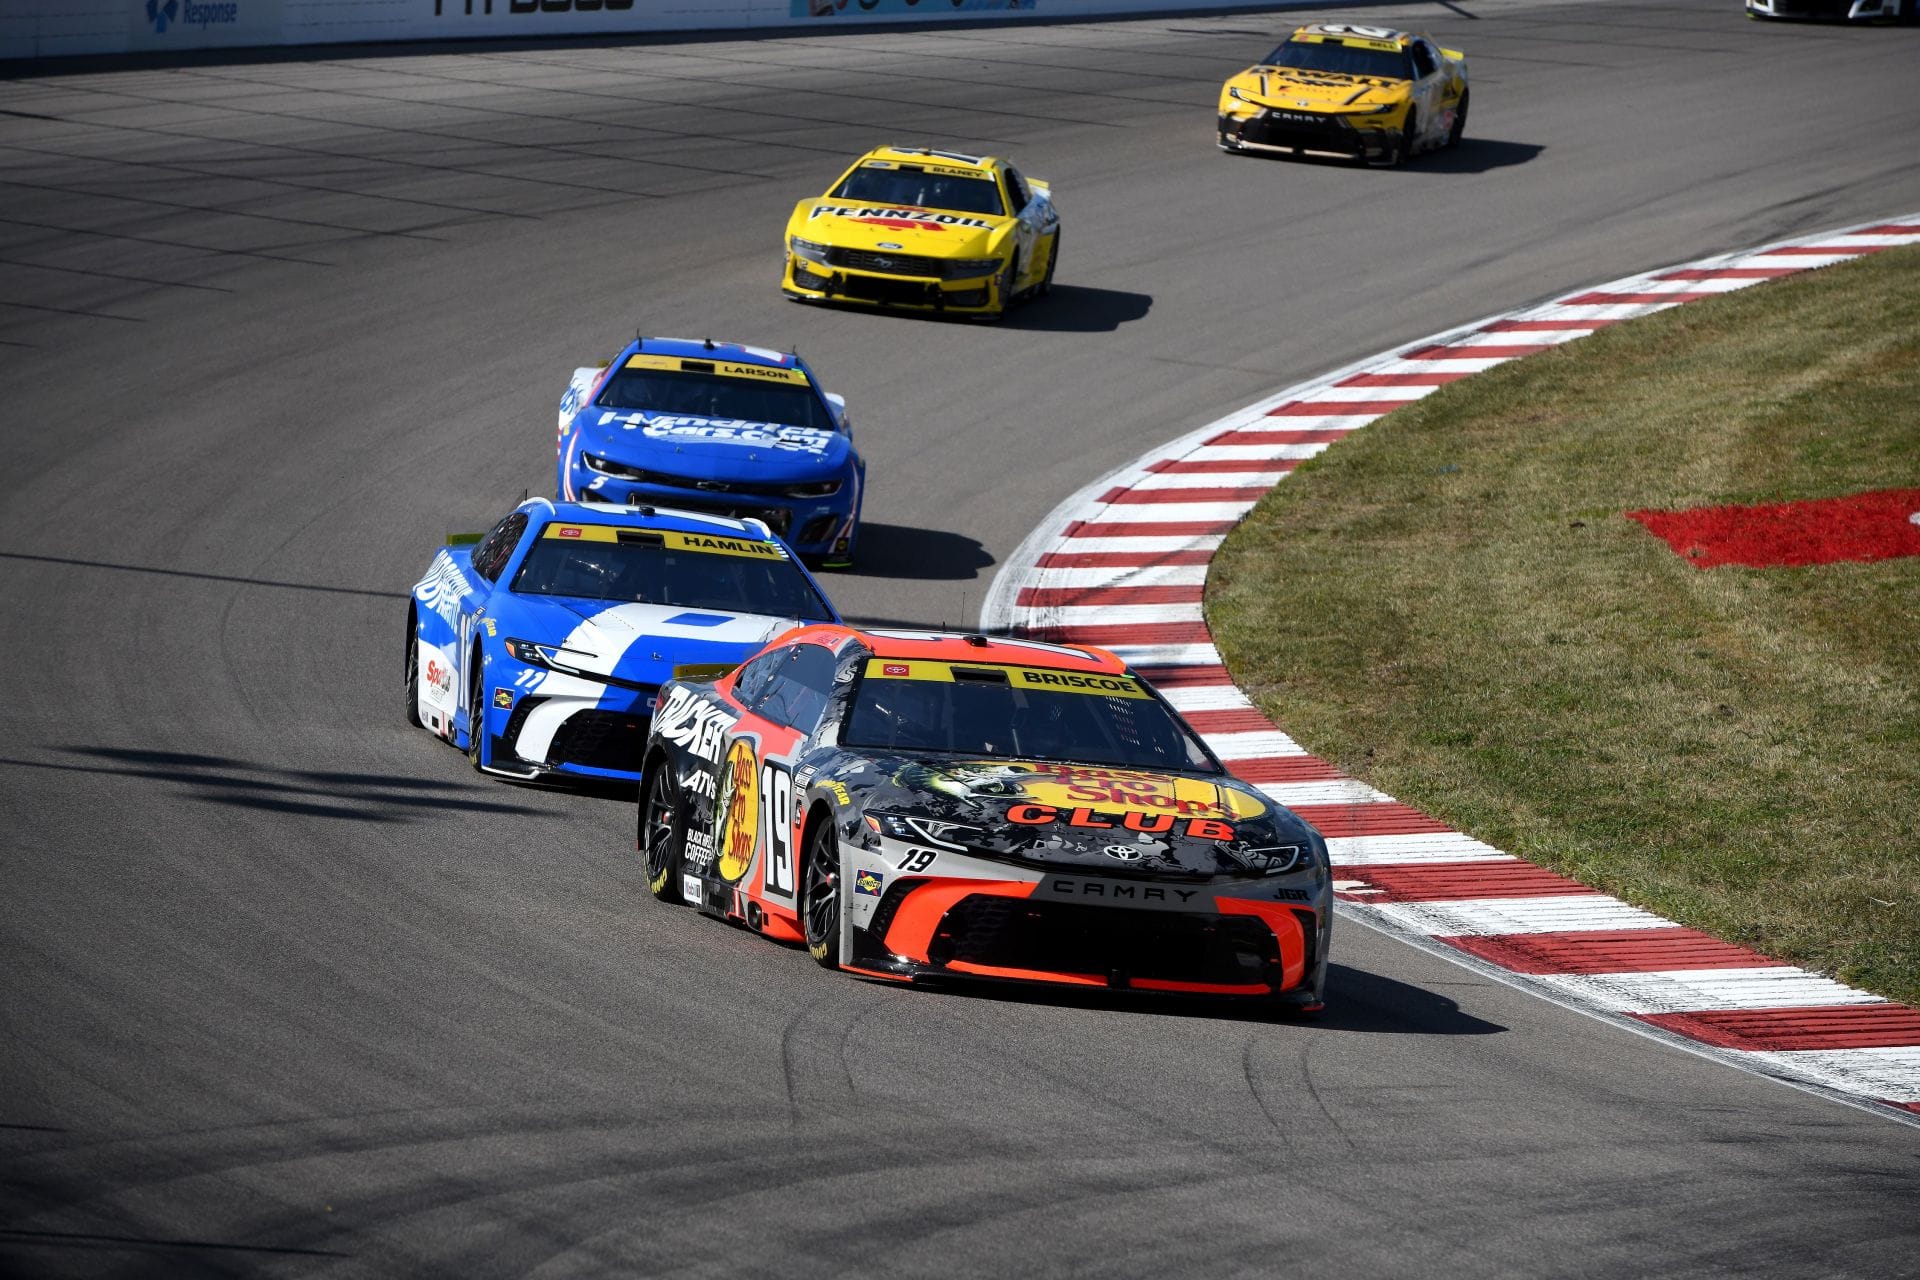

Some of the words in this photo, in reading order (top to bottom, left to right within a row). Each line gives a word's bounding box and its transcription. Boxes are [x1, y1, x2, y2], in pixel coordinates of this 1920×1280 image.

[184, 1, 237, 30] Response
[1271, 111, 1327, 123] CAMRY
[933, 166, 982, 178] BLANEY
[808, 206, 995, 231] PENNZOIL
[724, 366, 789, 379] LARSON
[588, 476, 609, 490] 5
[684, 536, 774, 555] HAMLIN
[514, 668, 547, 688] 11
[1022, 671, 1138, 693] BRISCOE
[653, 685, 737, 765] TRACKER
[734, 744, 752, 788] Bass
[1034, 763, 1171, 783] Bass
[1054, 772, 1158, 793] Pro
[732, 785, 745, 824] Pro
[1067, 785, 1239, 821] Shops
[761, 765, 793, 893] 19
[1007, 804, 1236, 841] CLUB
[686, 828, 702, 846] BLACK
[729, 819, 751, 871] Shops
[684, 841, 708, 866] COFFEE
[897, 848, 938, 873] 19
[858, 878, 881, 889] SUNOCO
[1053, 880, 1198, 902] CAMRY
[1273, 887, 1312, 901] JGR
